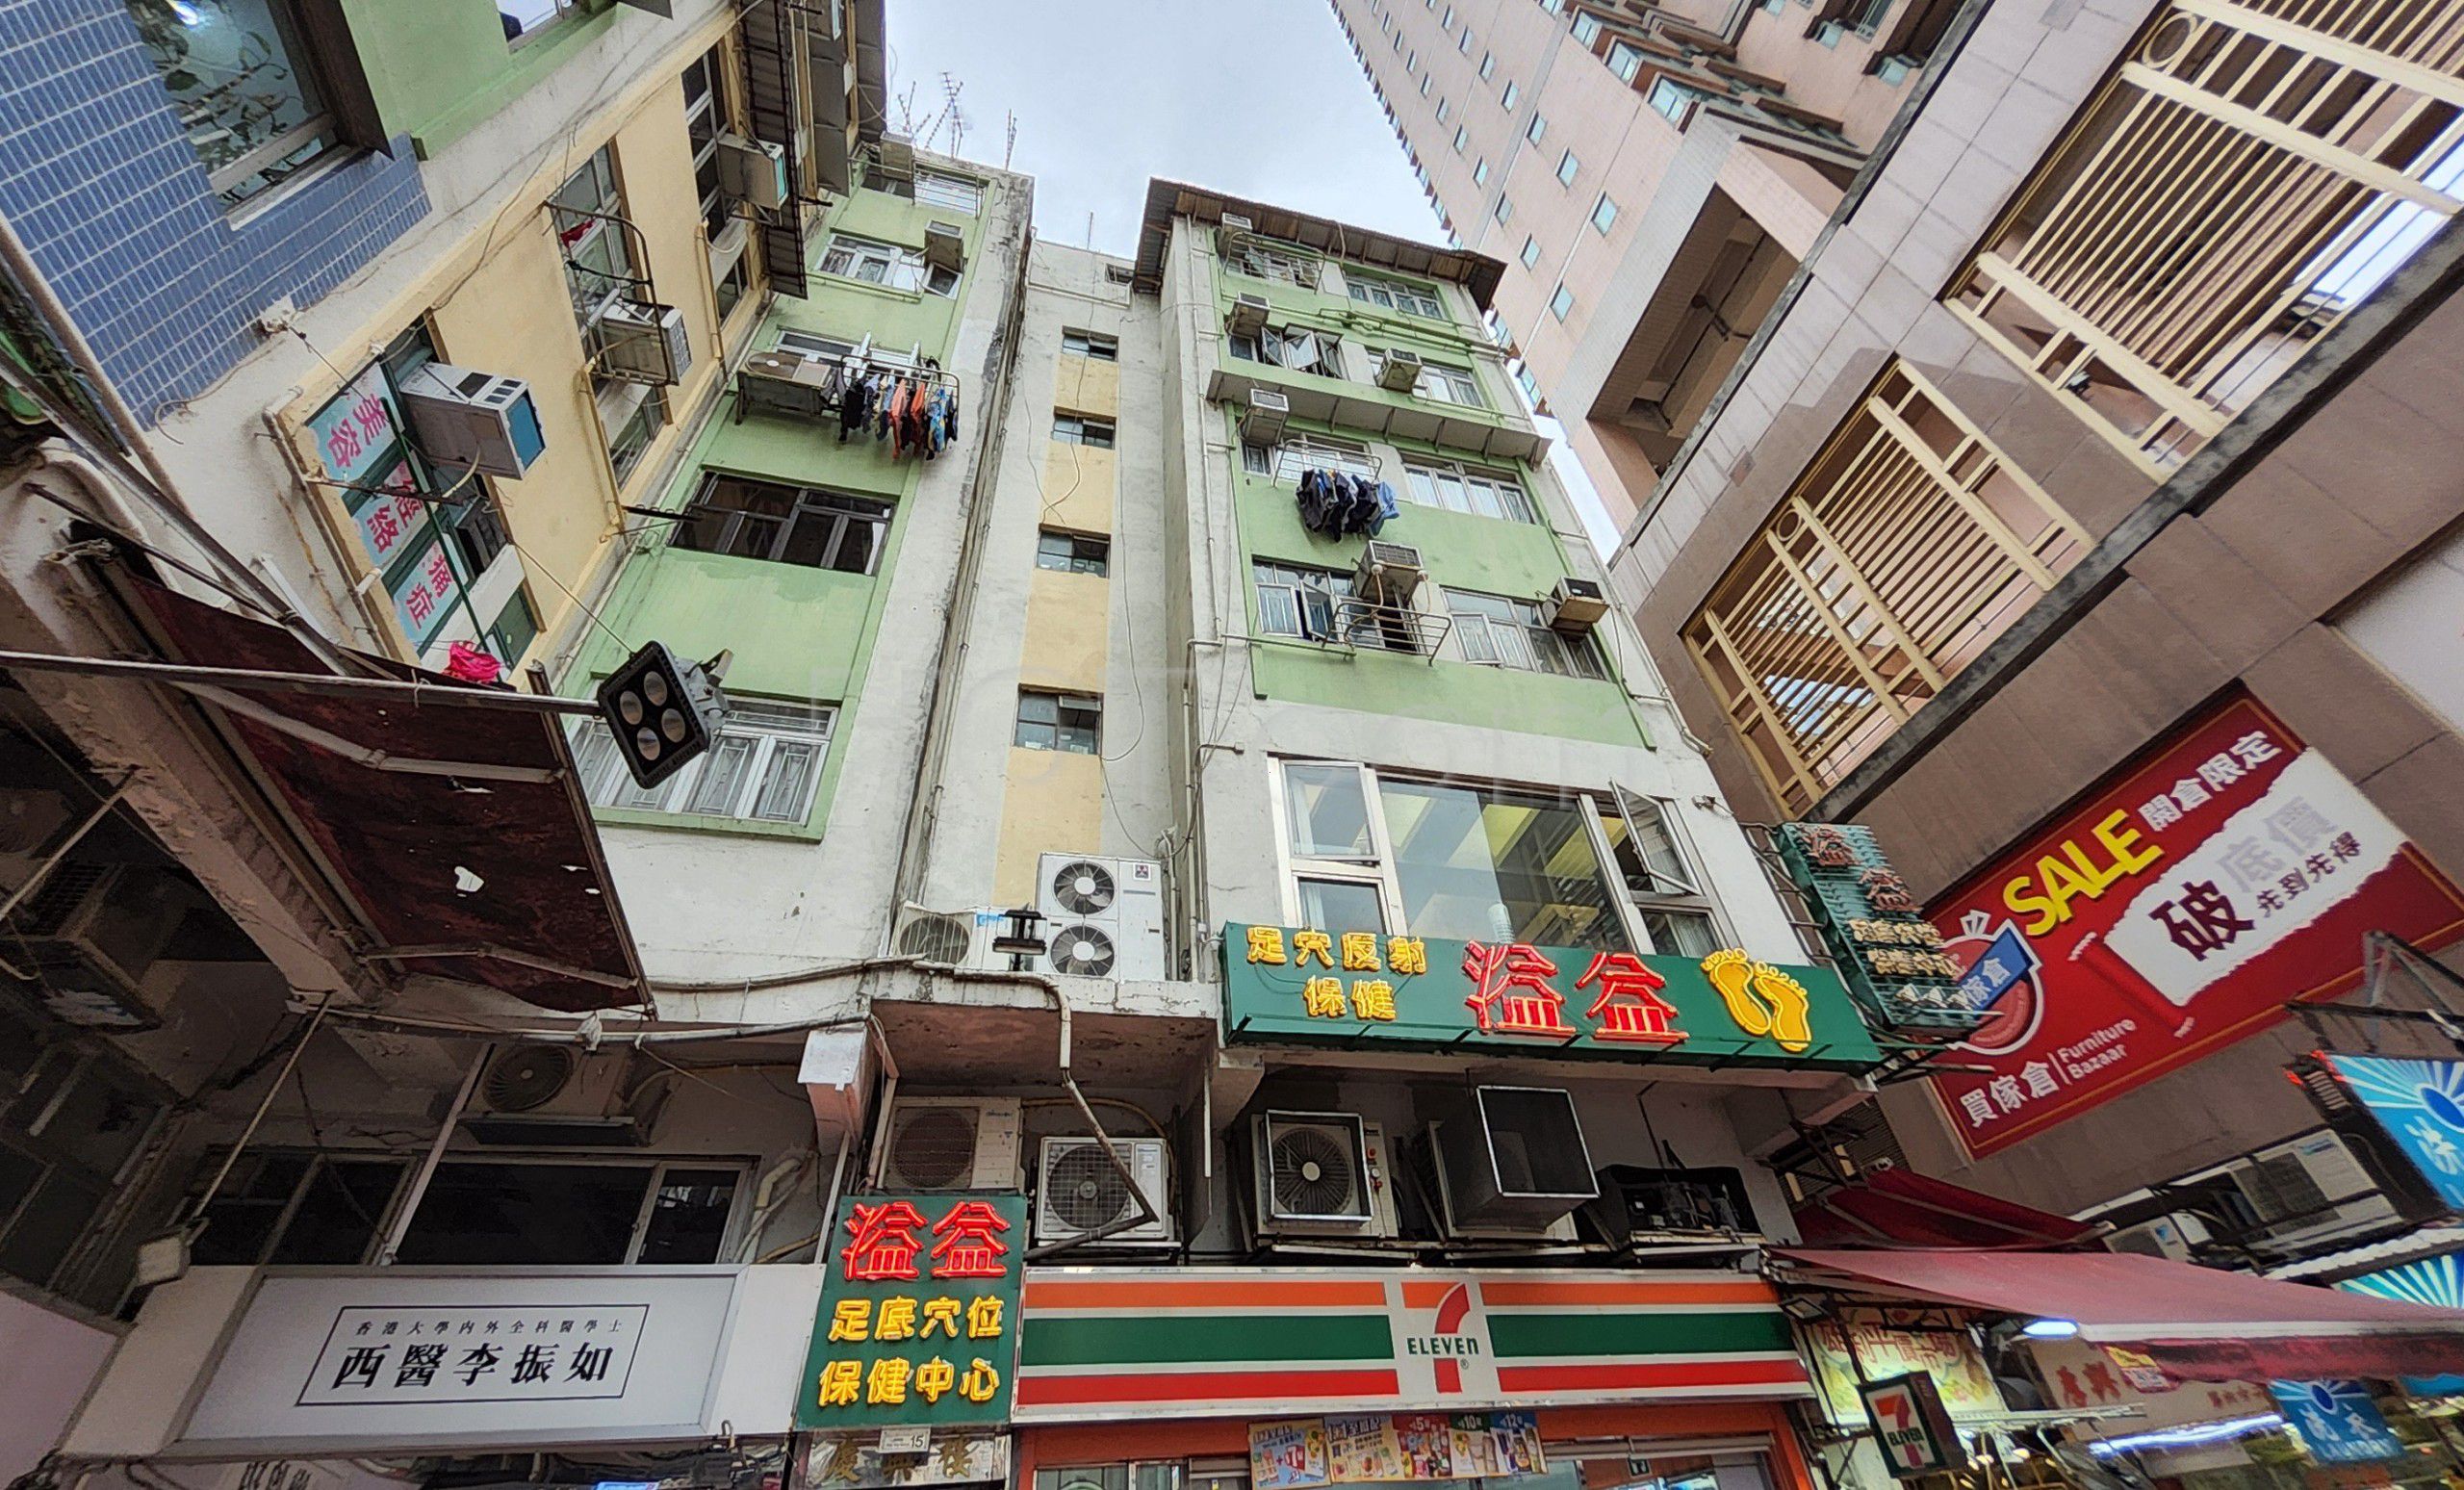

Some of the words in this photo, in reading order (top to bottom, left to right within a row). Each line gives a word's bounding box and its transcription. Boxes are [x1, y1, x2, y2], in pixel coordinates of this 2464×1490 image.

[327, 394, 387, 469] 美容
[2002, 809, 2165, 937] SALE
[2256, 831, 2361, 917] 先到先得
[1302, 974, 1398, 1021] 保健
[1461, 939, 1691, 1043] 溢益
[2057, 1018, 2137, 1064] Furniture
[2067, 1044, 2127, 1079] Bazaar
[1960, 1061, 2060, 1128] 買傢倉
[840, 1201, 1012, 1281] 溢益
[828, 1296, 1005, 1342] 足底穴位
[331, 1342, 614, 1390] 西醫李振如
[818, 1356, 1001, 1408] 保健中心
[910, 1433, 924, 1449] 15
